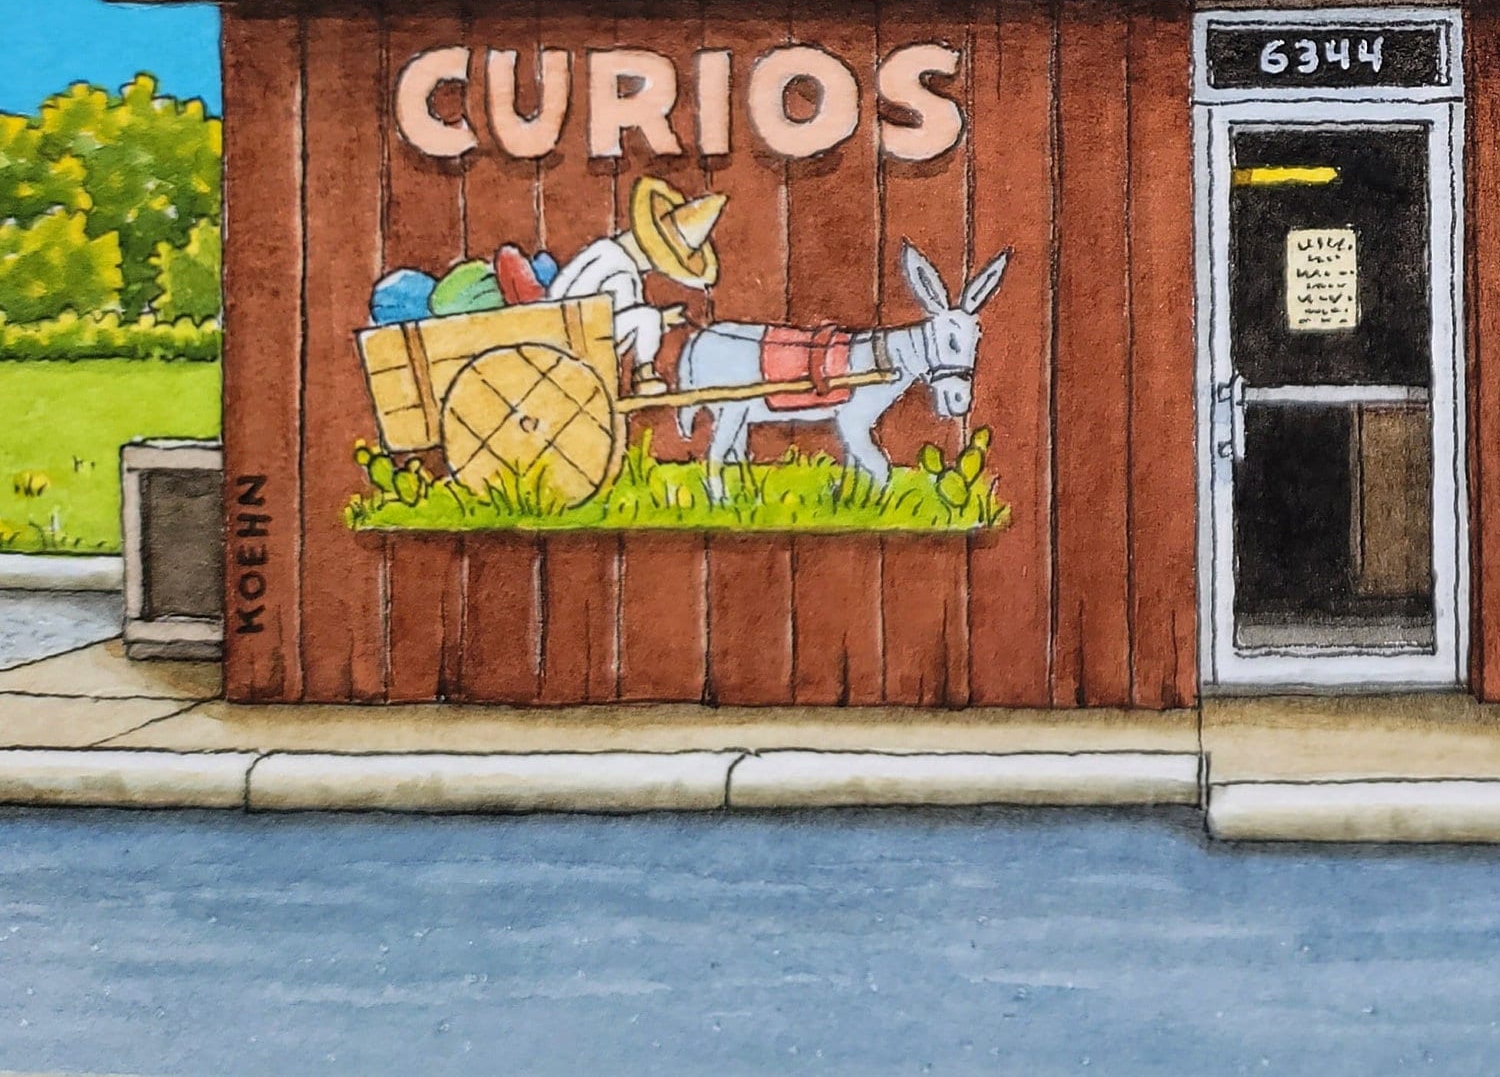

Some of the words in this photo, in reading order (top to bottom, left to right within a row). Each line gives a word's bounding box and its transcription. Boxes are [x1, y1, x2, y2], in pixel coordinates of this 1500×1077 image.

[396, 43, 965, 161] CURIOS
[1260, 35, 1385, 73] 6344
[236, 475, 272, 634] KOEHN
